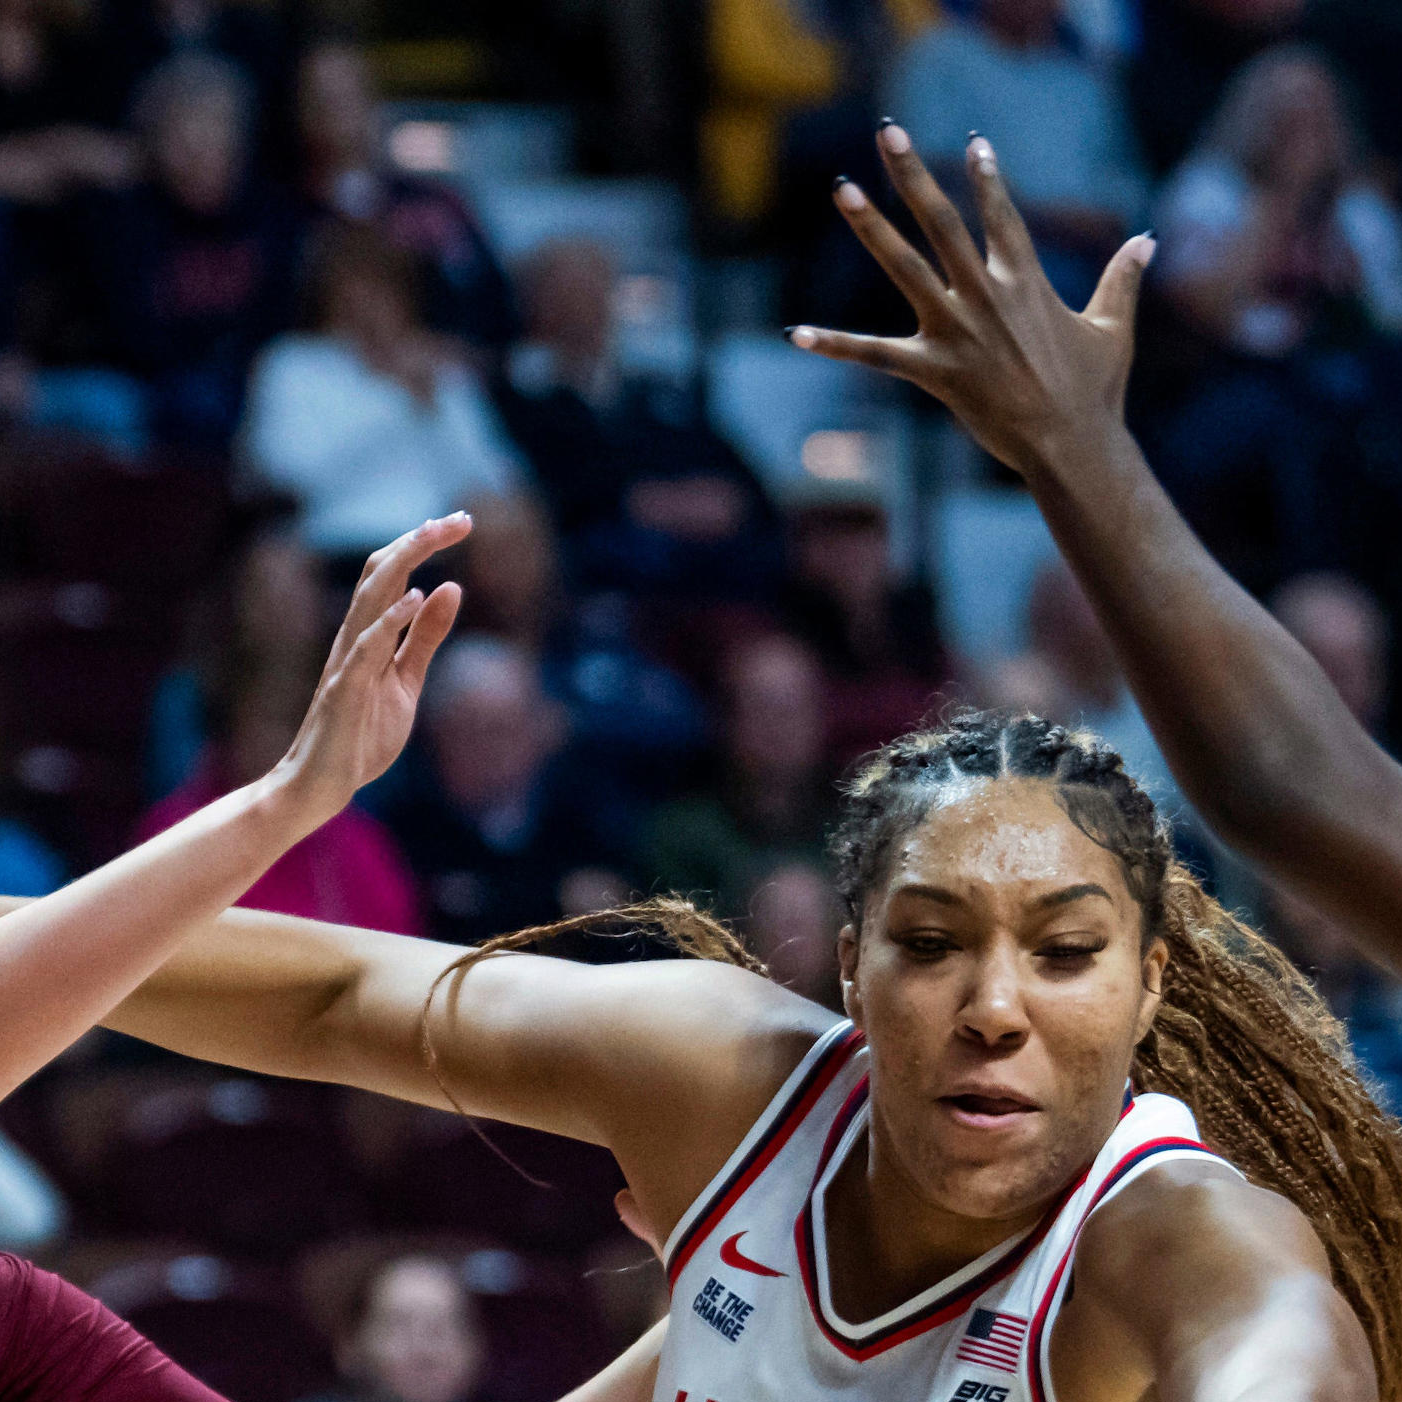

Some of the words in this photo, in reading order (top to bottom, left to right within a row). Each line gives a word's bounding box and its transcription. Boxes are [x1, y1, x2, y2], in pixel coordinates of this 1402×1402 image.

[691, 1292, 745, 1344] CHANGE
[702, 1276, 725, 1302] BE
[722, 1291, 755, 1324] THE
